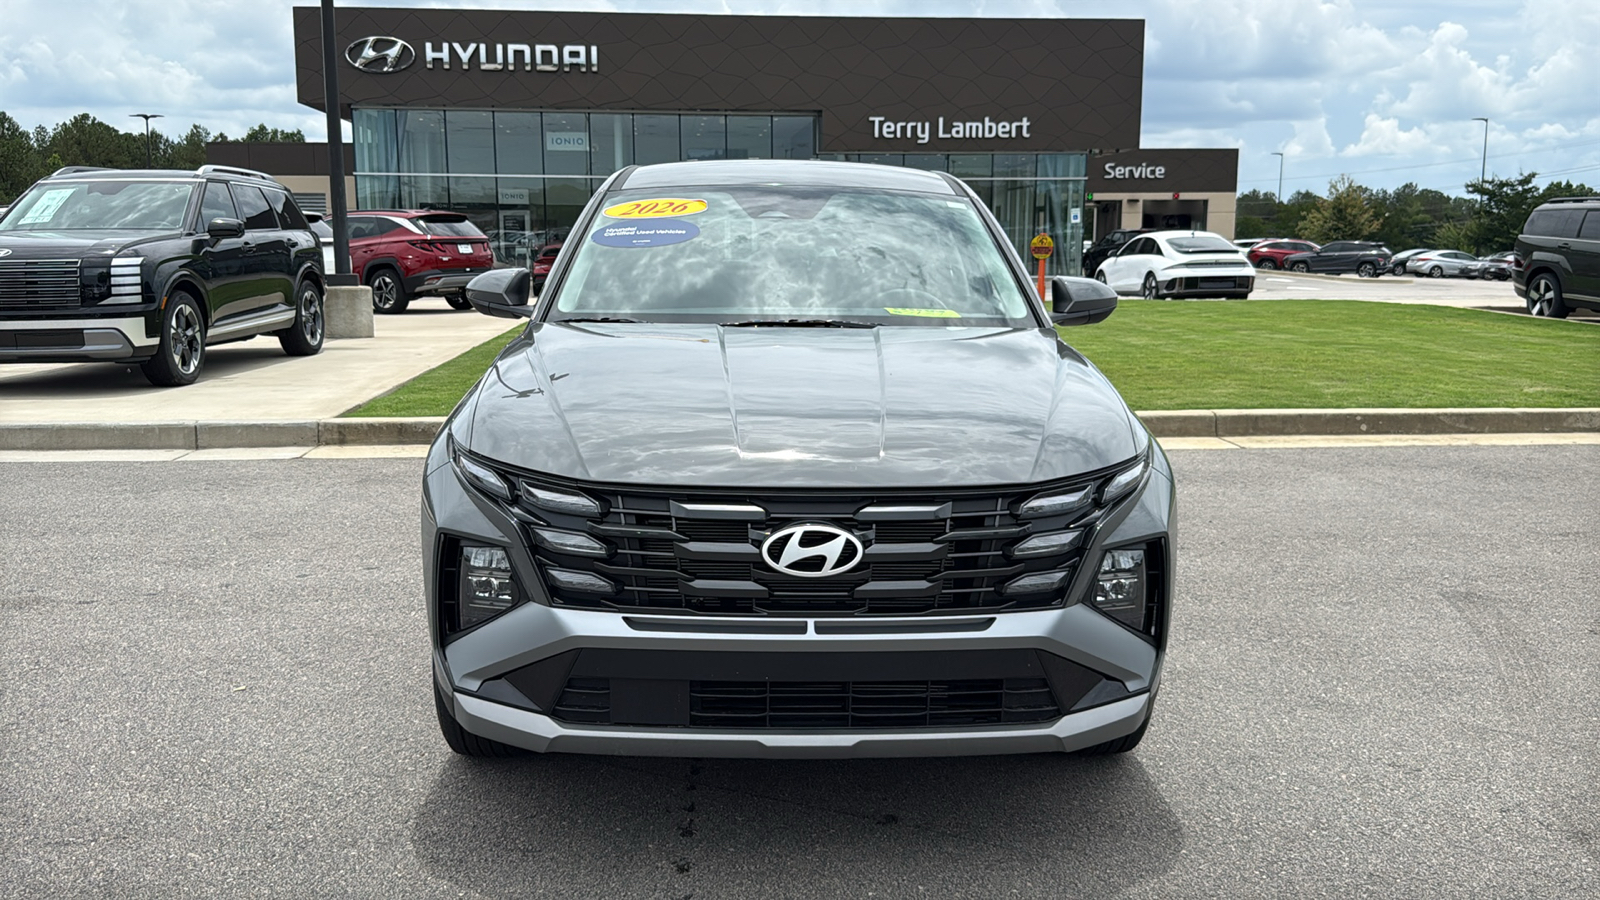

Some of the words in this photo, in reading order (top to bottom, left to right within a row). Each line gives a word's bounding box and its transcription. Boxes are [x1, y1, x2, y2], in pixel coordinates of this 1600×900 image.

[425, 42, 598, 72] HYUNDAI
[869, 117, 930, 144] Terry
[938, 117, 1031, 139] Lambert
[1103, 163, 1166, 179] Service
[618, 202, 689, 216] 2026
